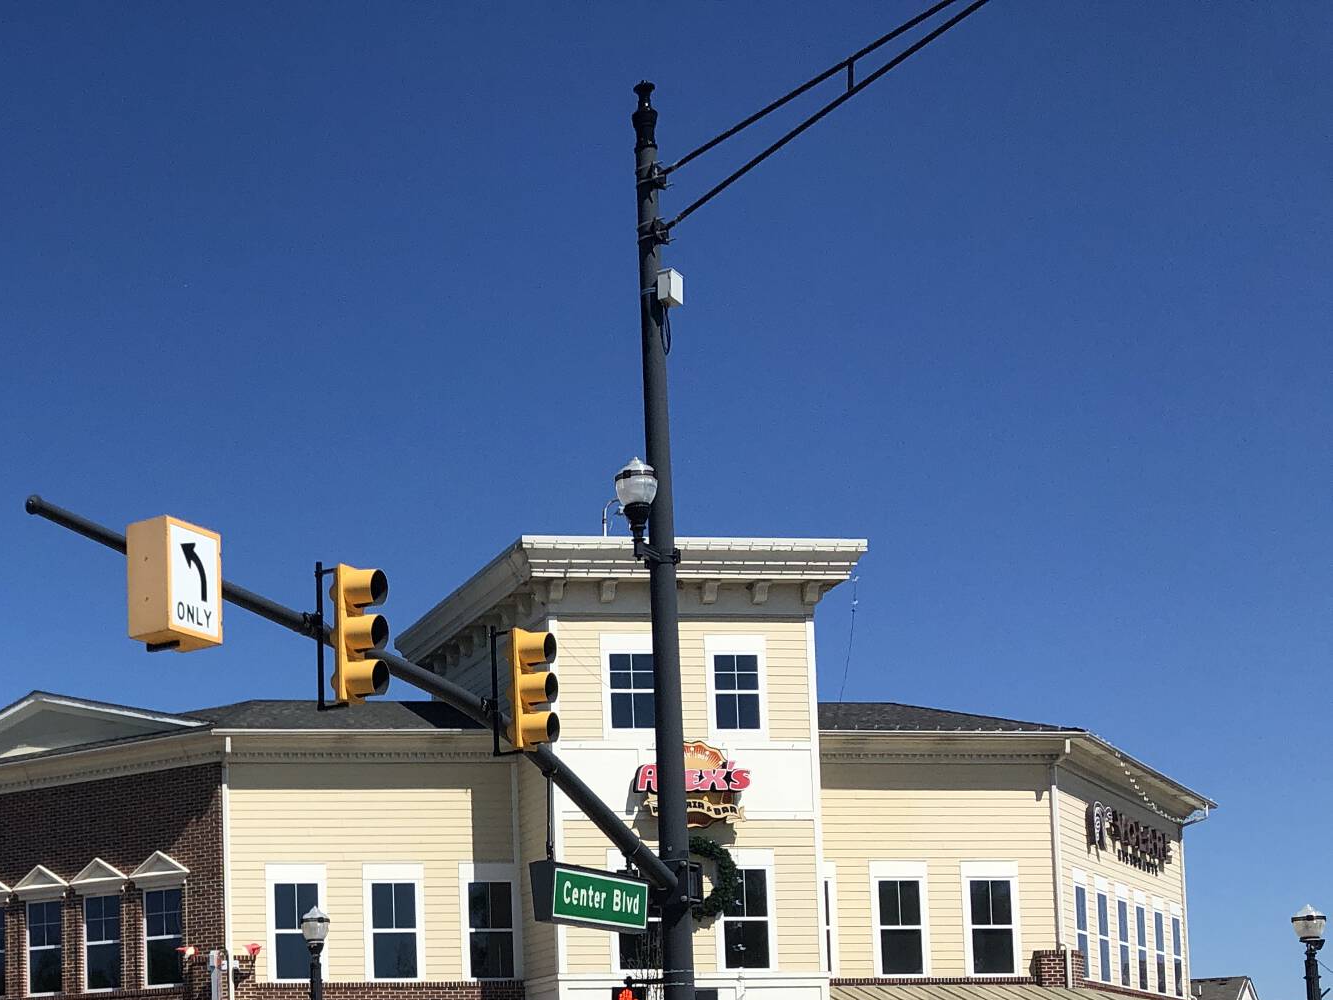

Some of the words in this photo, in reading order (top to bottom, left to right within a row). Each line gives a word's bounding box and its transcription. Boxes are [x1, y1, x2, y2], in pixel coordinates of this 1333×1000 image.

[177, 601, 212, 628] ONLY
[635, 760, 751, 792] AEX'S
[713, 804, 738, 816] BAR
[562, 880, 607, 909] Center
[612, 888, 640, 915] Blvd
